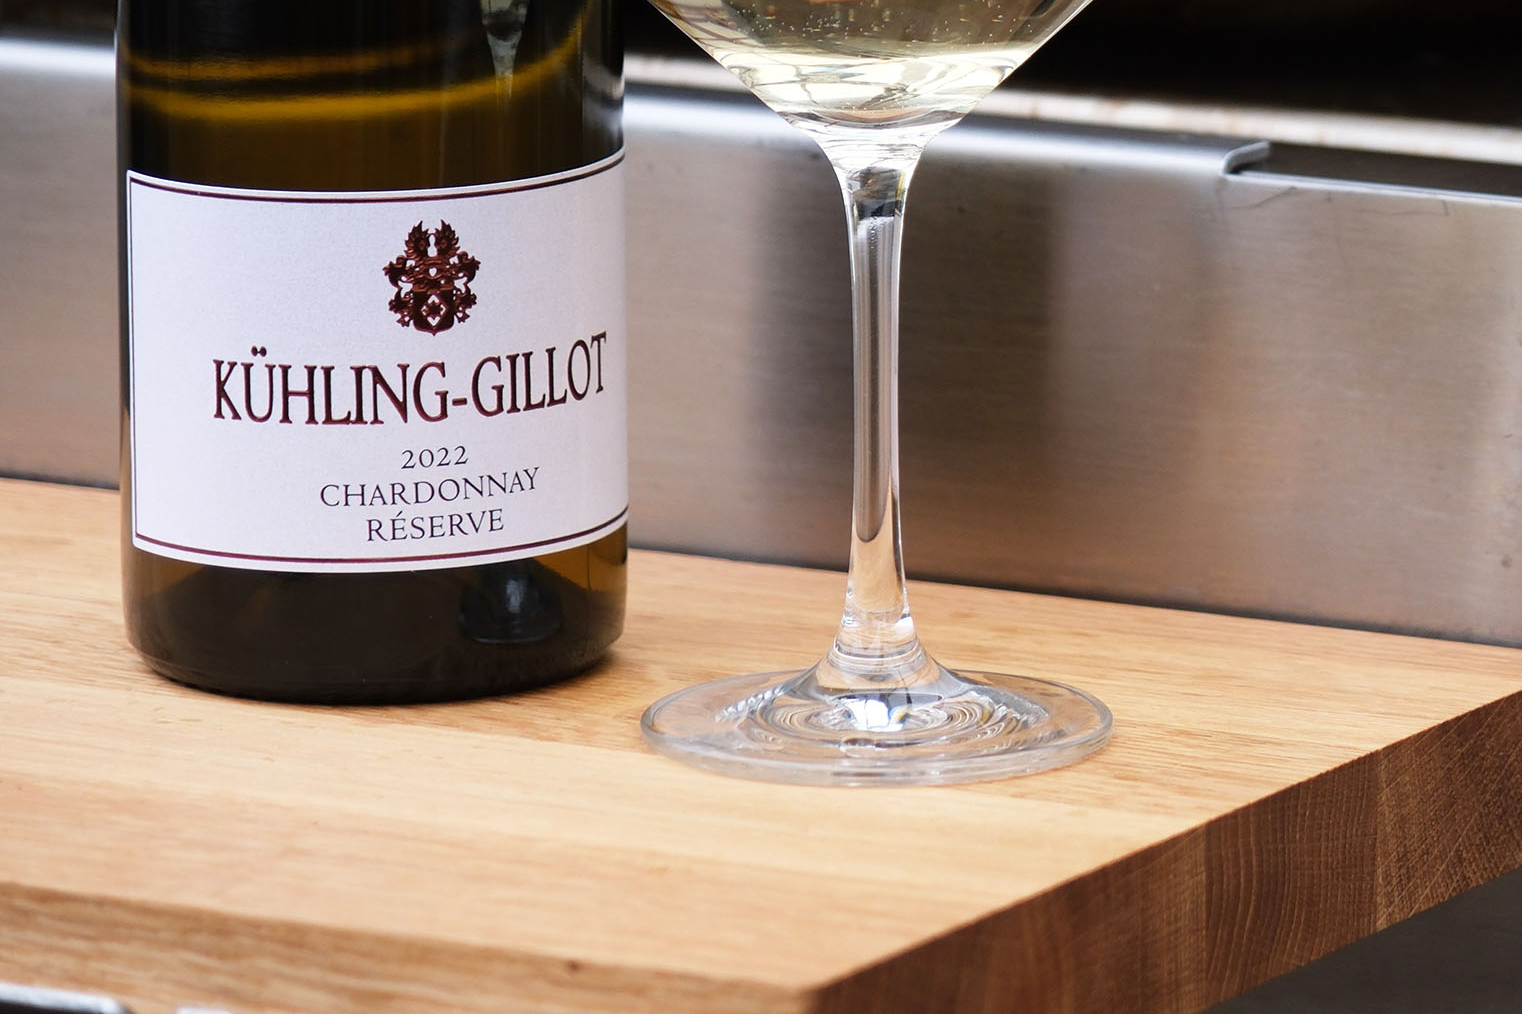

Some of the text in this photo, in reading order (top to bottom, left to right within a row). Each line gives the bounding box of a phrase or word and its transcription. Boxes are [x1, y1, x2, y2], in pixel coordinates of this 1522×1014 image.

[213, 331, 607, 425] KÜHLING-GILLOT
[401, 445, 469, 470] 2022
[320, 466, 540, 508] CHARDONNAY
[366, 508, 505, 543] RÉSERVE
